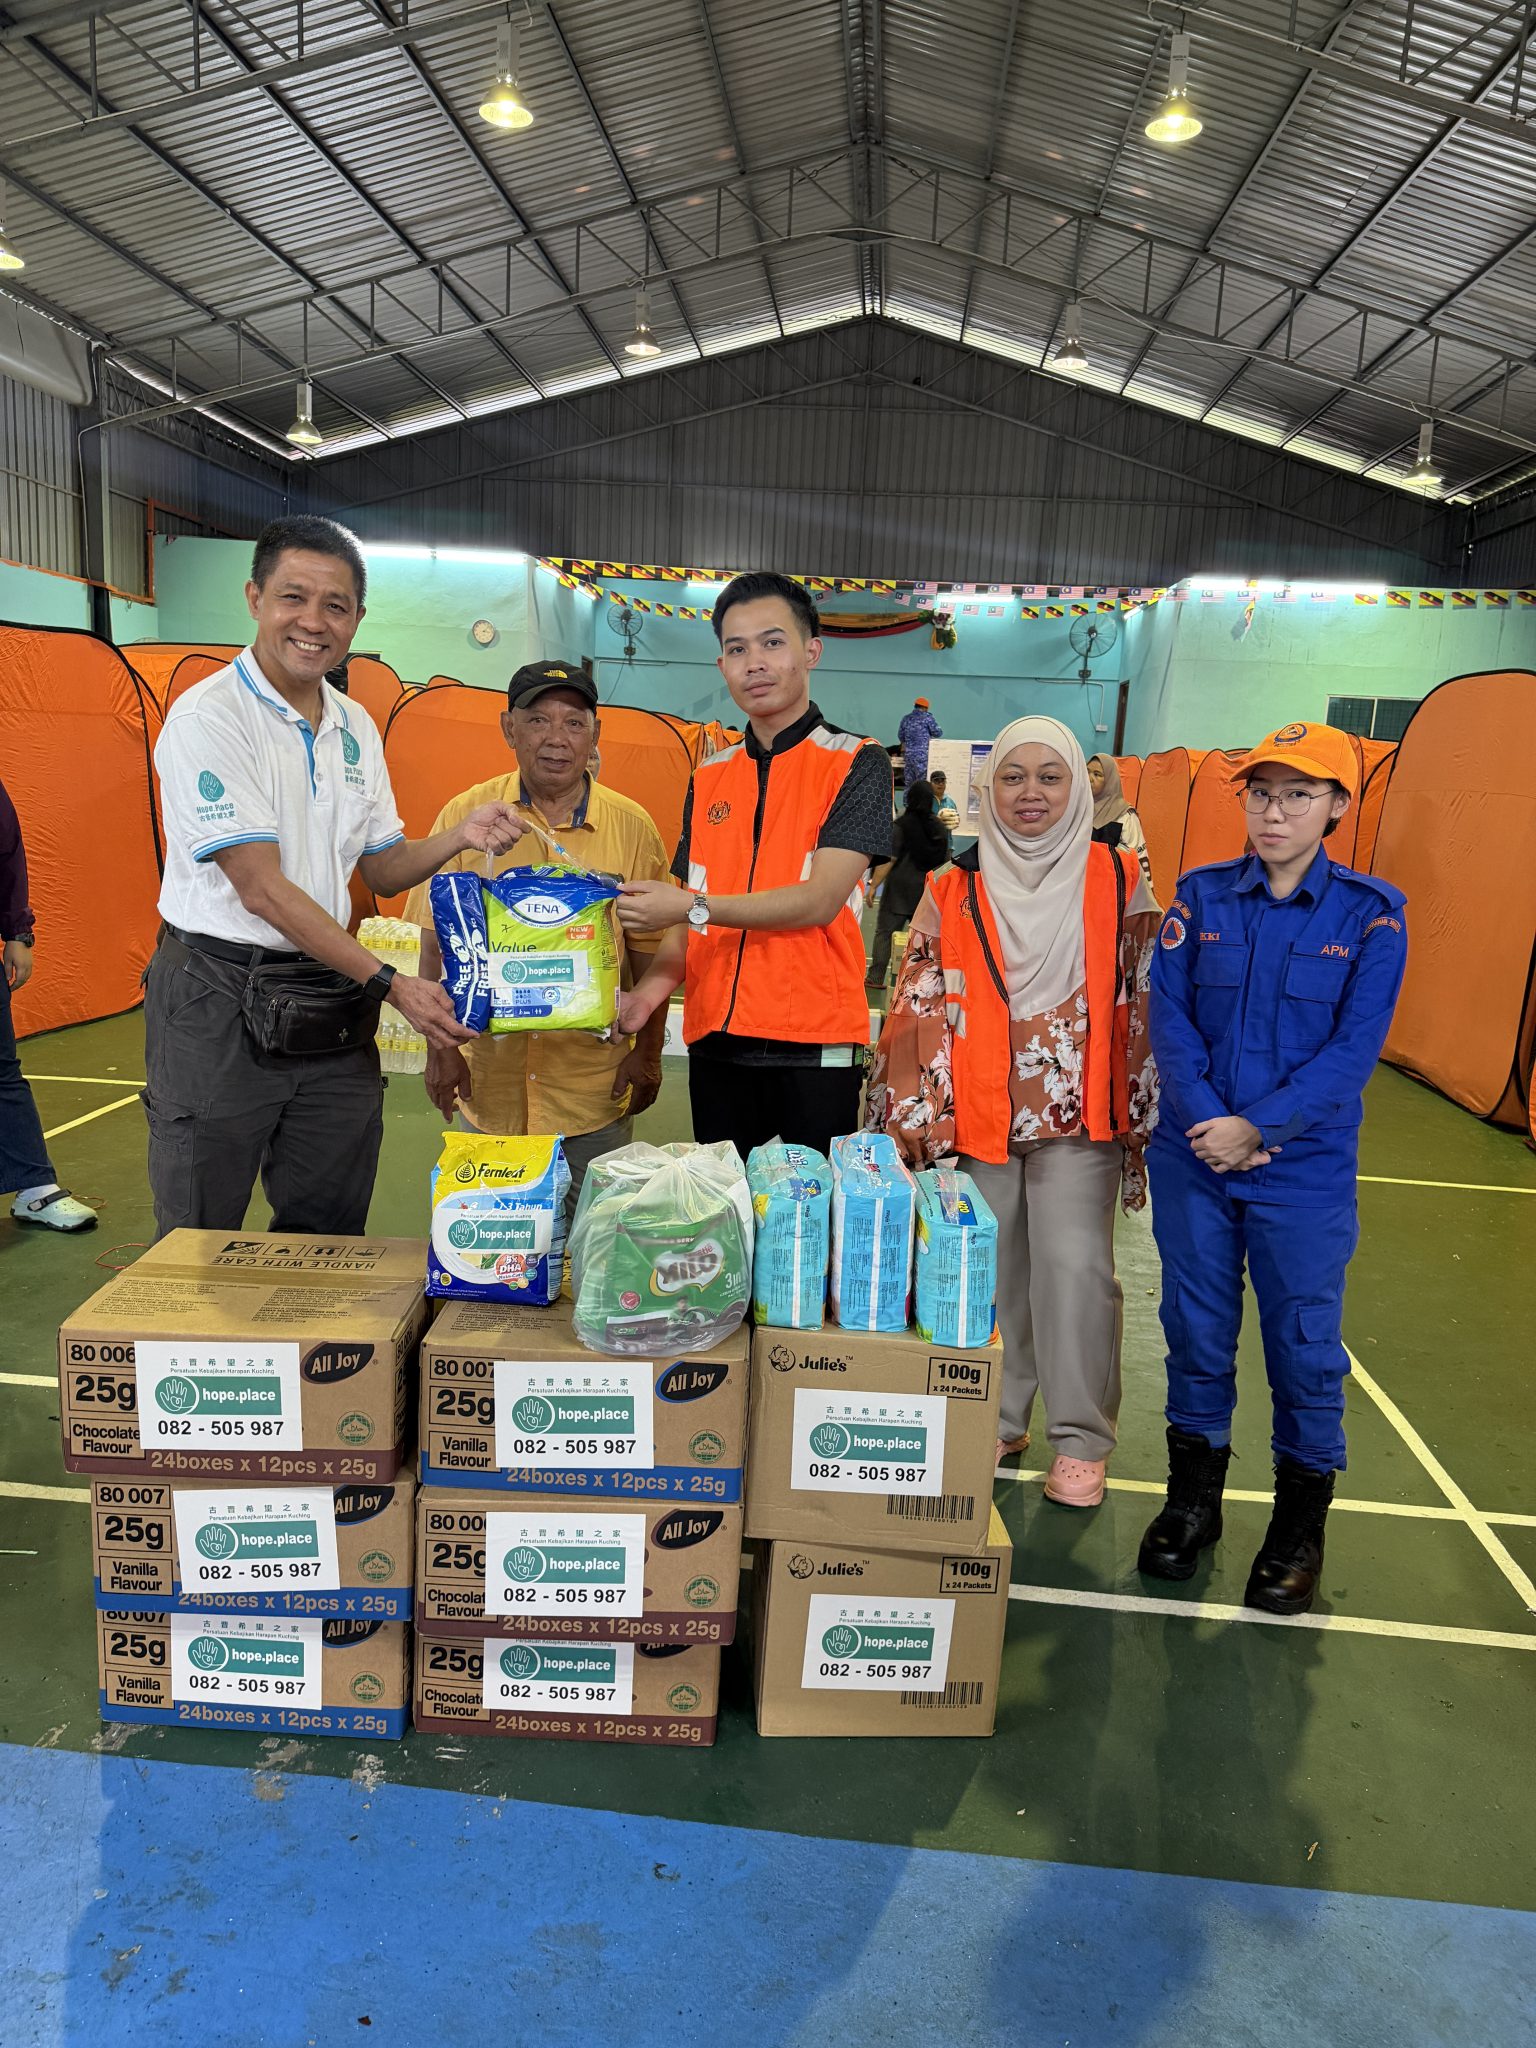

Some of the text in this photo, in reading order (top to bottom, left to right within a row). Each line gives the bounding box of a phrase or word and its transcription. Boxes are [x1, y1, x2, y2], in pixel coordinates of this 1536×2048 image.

[525, 903, 559, 914] TENA
[491, 941, 537, 952] Value
[1320, 945, 1349, 958] APM
[453, 945, 472, 995] FREE 3
[529, 966, 570, 975] hope.place
[476, 962, 490, 997] FREE
[478, 1163, 527, 1178] Fernleaf
[480, 1228, 531, 1240] hope.place
[212, 1256, 376, 1270] HANDLE WITH CARE
[500, 1263, 522, 1274] DHA
[657, 1253, 718, 1285] MILO
[70, 1344, 135, 1363] 80 006
[311, 1352, 361, 1375] All Joy
[434, 1360, 494, 1378] 80 007
[799, 1356, 847, 1373] Julie's
[938, 1363, 981, 1384] 100g
[666, 1371, 715, 1393] All Joy
[952, 1385, 982, 1395] Packets
[75, 1375, 136, 1411] 25g
[202, 1387, 276, 1403] hope.place
[436, 1388, 494, 1425] 25g
[558, 1408, 629, 1423] hope.place
[72, 1423, 140, 1440] Chocolate
[158, 1420, 284, 1436] 082 505 987
[83, 1439, 132, 1454] Flavour
[442, 1436, 488, 1452] Vanilla
[513, 1439, 636, 1455] 082 505 987
[853, 1435, 922, 1451] hope.place
[151, 1451, 377, 1479] 24boxes x 12pcs x 25g
[439, 1452, 491, 1468] Flavour
[809, 1463, 927, 1483] 082 505 987
[507, 1467, 726, 1496] 24boxes x 12pcs x 25g
[100, 1487, 165, 1504] 80 007
[335, 1493, 382, 1515] All Joy
[430, 1514, 486, 1530] 80 00
[662, 1518, 711, 1542] All Joy
[105, 1515, 164, 1549] 25g
[241, 1532, 313, 1548] hope.place
[432, 1543, 486, 1576] 25g
[550, 1558, 620, 1572] hope.place
[113, 1561, 158, 1576] Vanilla
[199, 1562, 322, 1580] 082 505 987
[817, 1561, 864, 1577] Julie's
[950, 1561, 991, 1579] 100g
[111, 1576, 162, 1591] Flavour
[178, 1591, 398, 1615] 24boxes x 12pcs x 25g
[428, 1589, 486, 1604] Chocolat
[503, 1588, 627, 1604] 082 505 987
[437, 1604, 485, 1618] Flavour
[326, 1619, 372, 1638] All Joy
[502, 1615, 721, 1638] 24boxes x 12pcs x 25g
[110, 1632, 166, 1664] 25g
[864, 1636, 929, 1650] hope.place
[232, 1649, 299, 1664] hope.place
[429, 1647, 483, 1677] 25g
[543, 1658, 611, 1672] hope.place
[819, 1663, 932, 1679] 082 505 987
[118, 1675, 160, 1691] Vanilla
[189, 1675, 306, 1695] 082 505 987
[116, 1689, 164, 1705] Flavour
[500, 1684, 616, 1701] 082 505 987
[433, 1703, 479, 1717] Flavour
[179, 1704, 387, 1734] 24boxes x 12pcs x 25g
[495, 1715, 702, 1741] 24boxes x 12pcs x 25g
